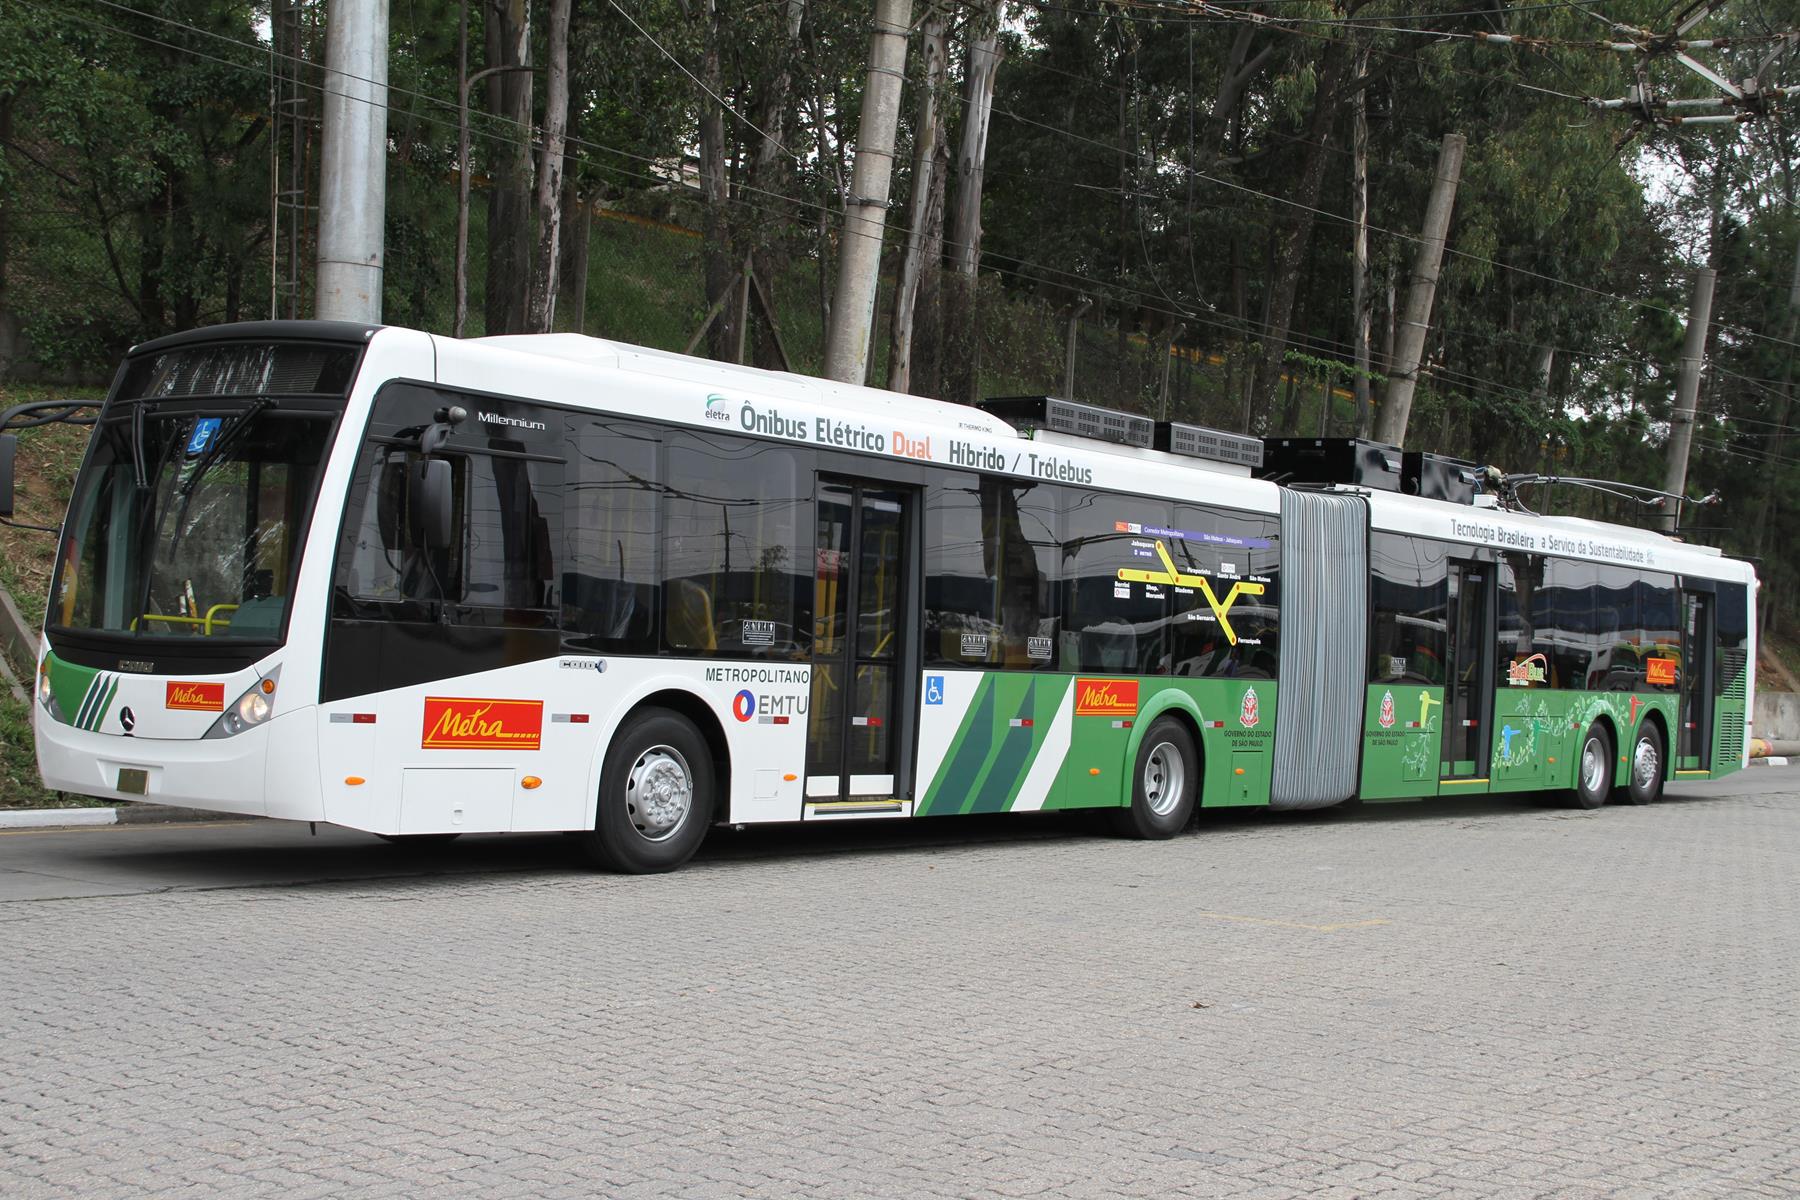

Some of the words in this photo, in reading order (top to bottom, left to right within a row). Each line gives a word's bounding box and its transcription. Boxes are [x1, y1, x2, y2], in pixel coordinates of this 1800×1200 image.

[478, 411, 545, 430] Millennium
[705, 409, 730, 421] eletra
[740, 400, 807, 439] Ônibus
[816, 417, 885, 452] Elétrico
[892, 431, 932, 460] Dual
[950, 440, 1005, 471] Híbrido
[1028, 454, 1092, 484] Trólebus
[1451, 519, 1494, 542] Tecnologia
[1497, 527, 1534, 548] Brasileira
[1549, 535, 1575, 555] Serviço
[1578, 540, 1586, 554] da
[1589, 541, 1643, 562] Sustentabilidade
[706, 668, 809, 683] METROPOLITANO
[169, 685, 205, 705] Metra
[1078, 682, 1120, 710] Metra
[759, 696, 807, 715] EMTU
[427, 702, 505, 742] Metra
